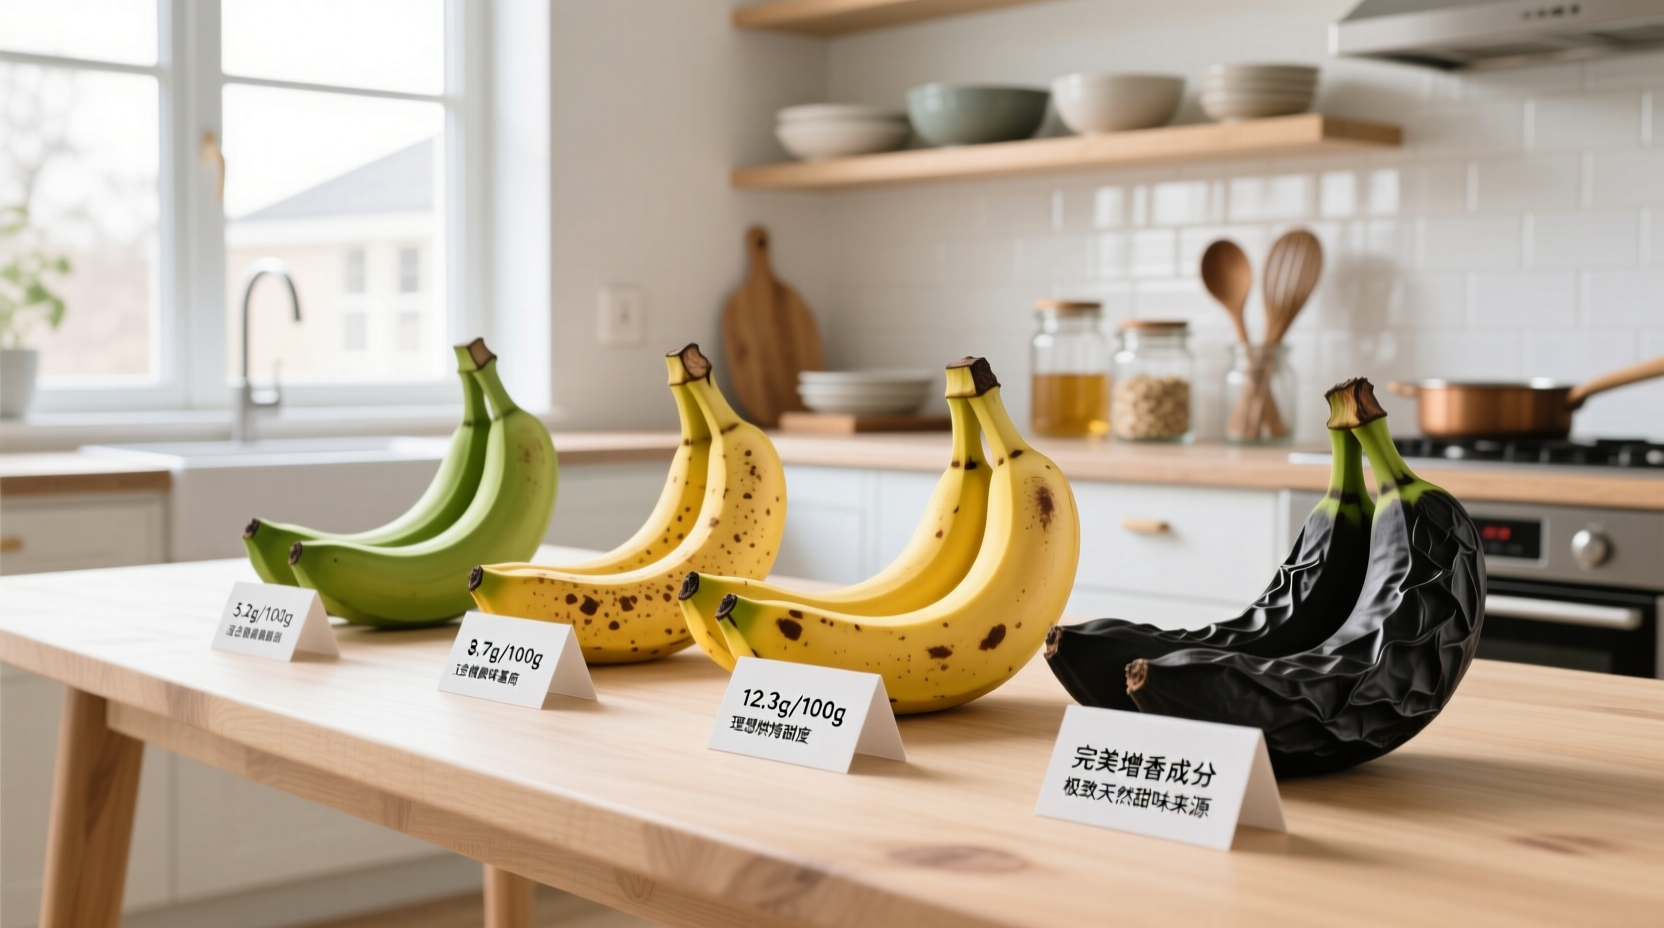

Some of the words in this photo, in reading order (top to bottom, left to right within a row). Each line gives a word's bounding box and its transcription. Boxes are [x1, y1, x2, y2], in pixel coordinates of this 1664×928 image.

[743, 688, 847, 727] 12.3g/100g
[1071, 744, 1217, 788] 完美增香成分
[1063, 776, 1213, 819] 极致天然甜味来源
